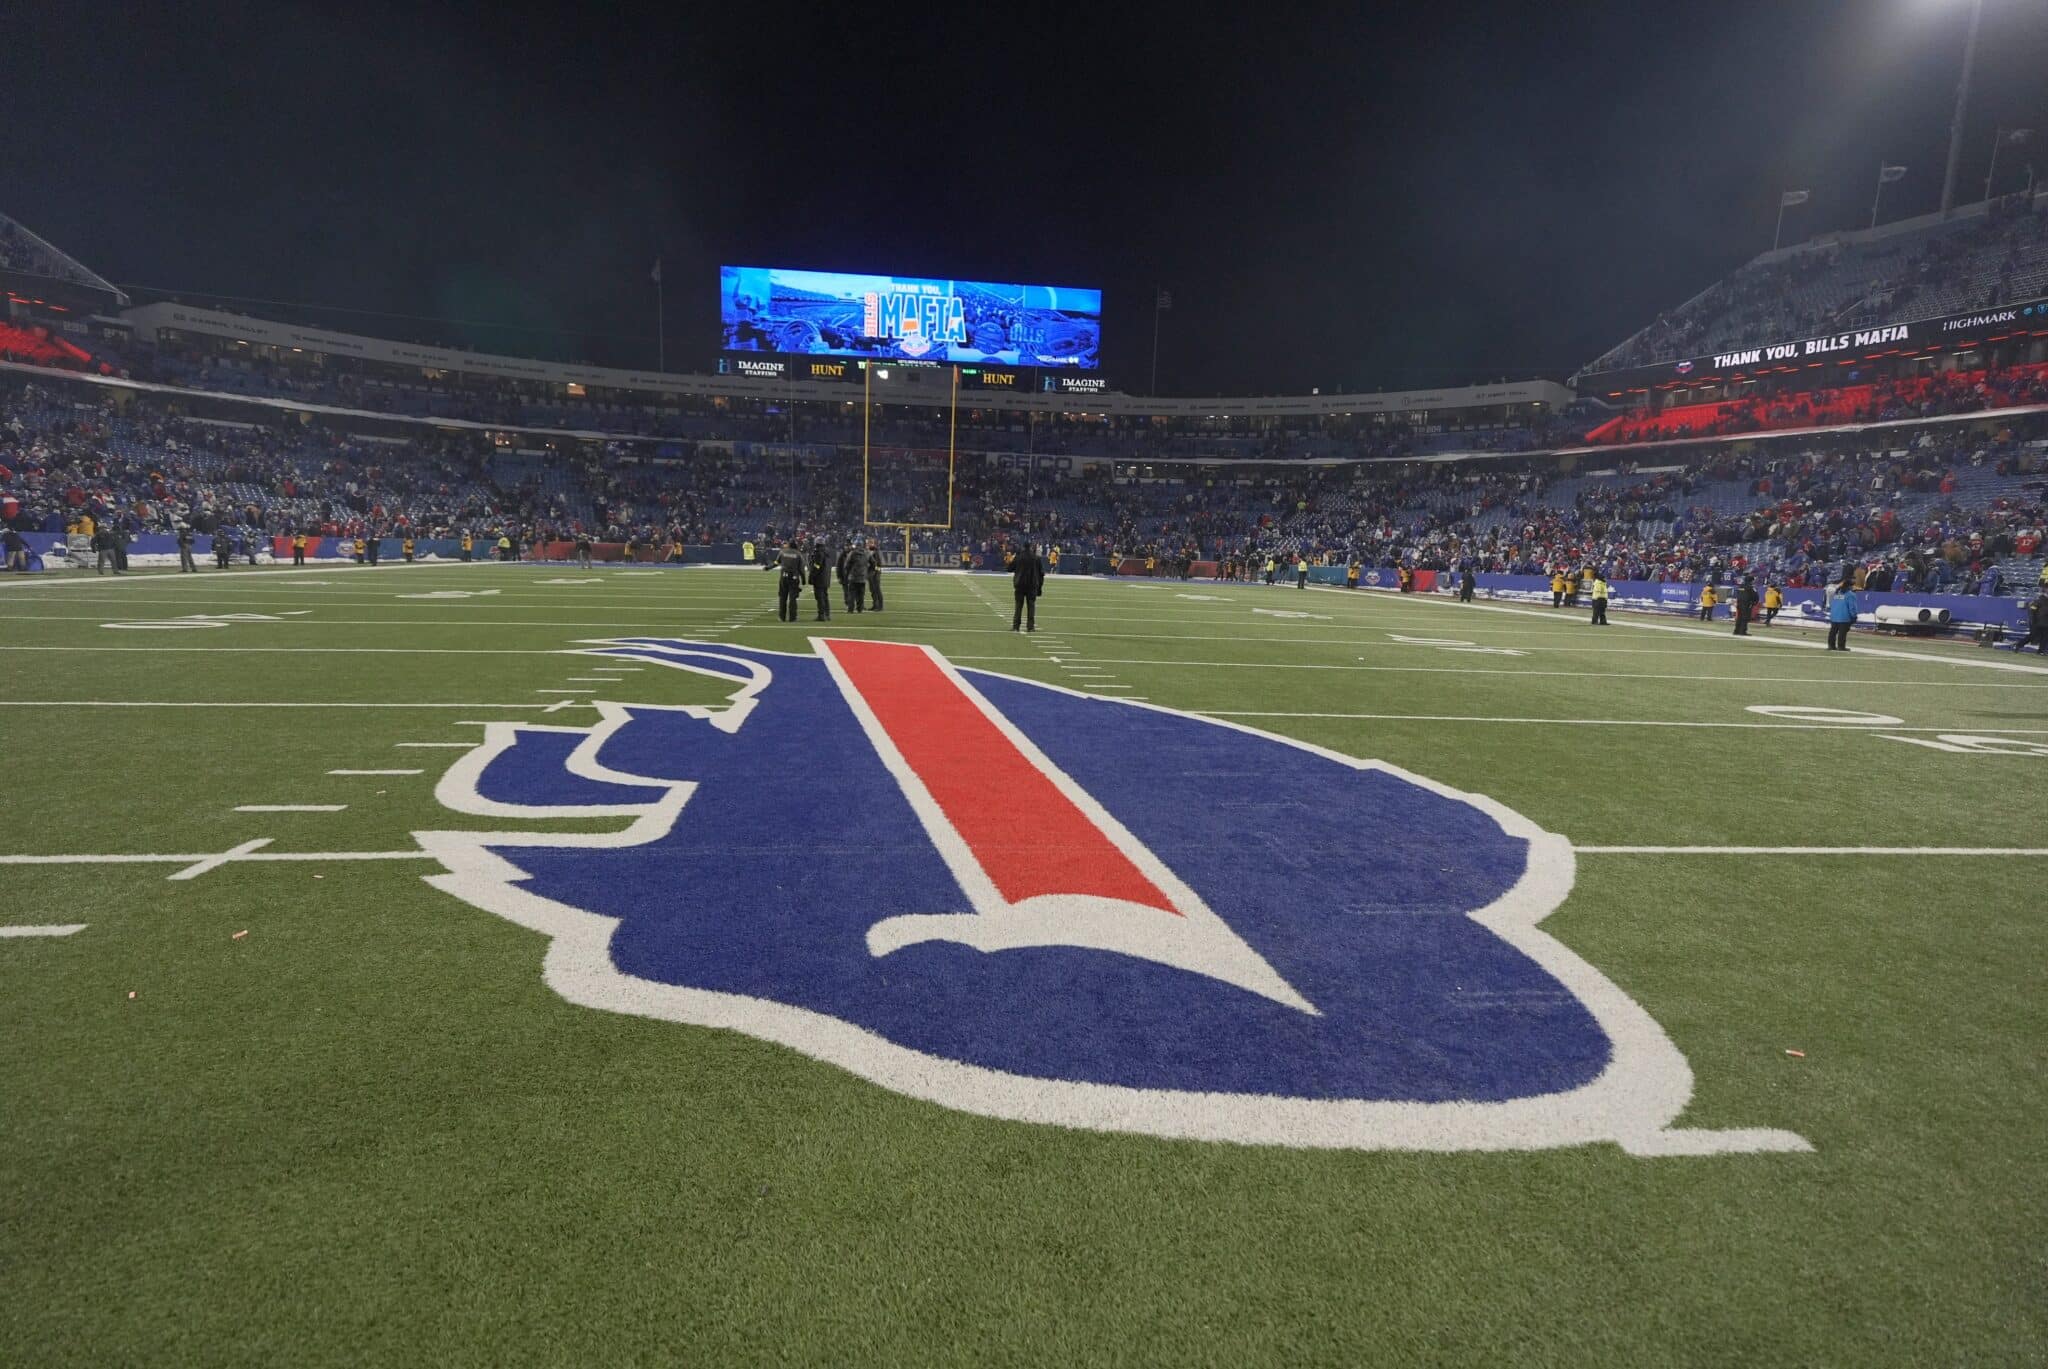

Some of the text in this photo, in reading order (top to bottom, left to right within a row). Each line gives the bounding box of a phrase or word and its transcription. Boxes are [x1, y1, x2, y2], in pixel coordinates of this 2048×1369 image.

[889, 283, 919, 292] THANK
[879, 293, 967, 342] MAFIA
[1713, 325, 1909, 369] THANK YOU, BILLS MAFIA
[738, 361, 785, 371] IMAGINE
[811, 364, 844, 376] HUNT
[983, 373, 1015, 385] HUNT
[1062, 378, 1105, 388] IMAGINE
[998, 454, 1073, 471] GEICO
[912, 553, 961, 568] BILLS
